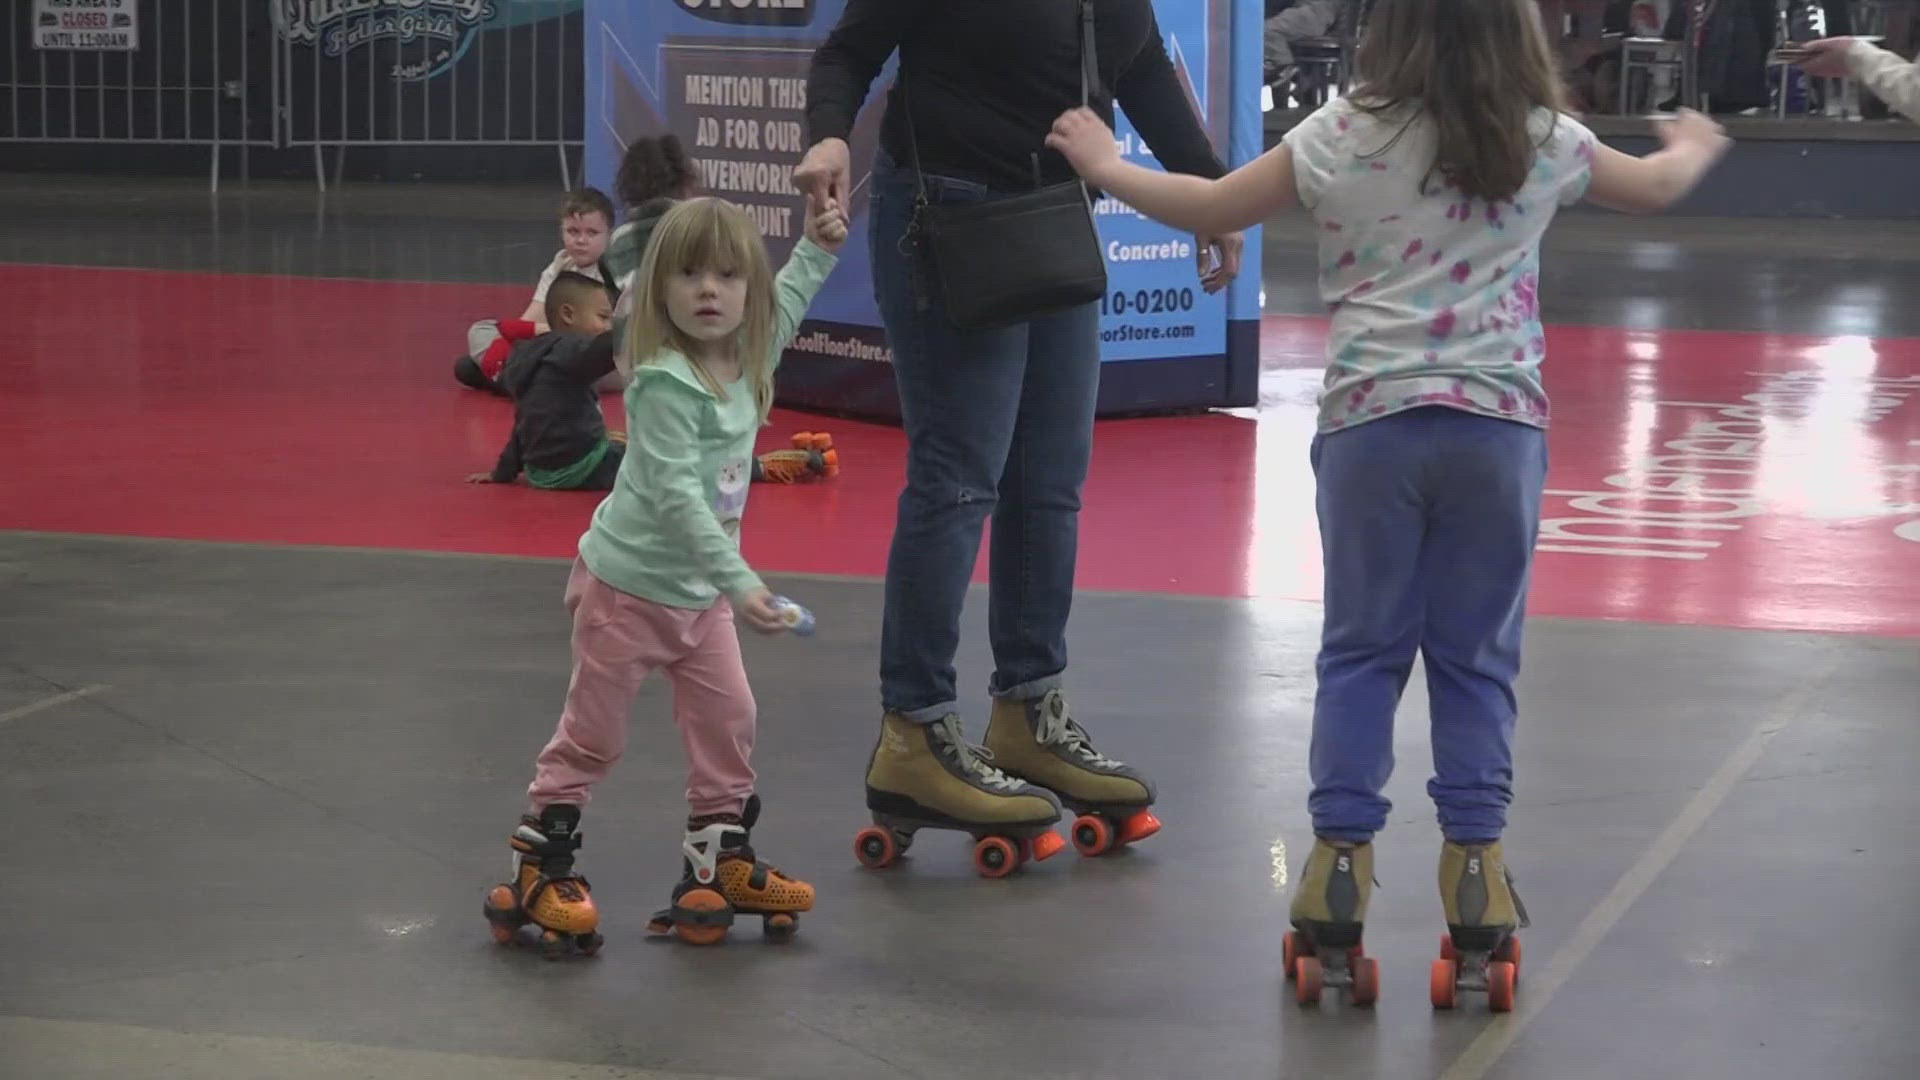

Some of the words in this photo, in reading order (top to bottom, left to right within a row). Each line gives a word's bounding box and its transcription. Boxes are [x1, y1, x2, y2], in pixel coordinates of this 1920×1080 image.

[62, 11, 107, 27] CLOSED
[42, 33, 75, 46] UNTIL
[685, 75, 764, 108] MENTION
[768, 77, 807, 110] THIS
[696, 117, 719, 147] AD
[725, 119, 760, 150] FOR
[764, 121, 802, 152] OUR
[692, 158, 801, 196] IVERWORK
[1107, 240, 1191, 262] Concrete
[1336, 856, 1350, 872] 5
[1468, 859, 1480, 874] 5
